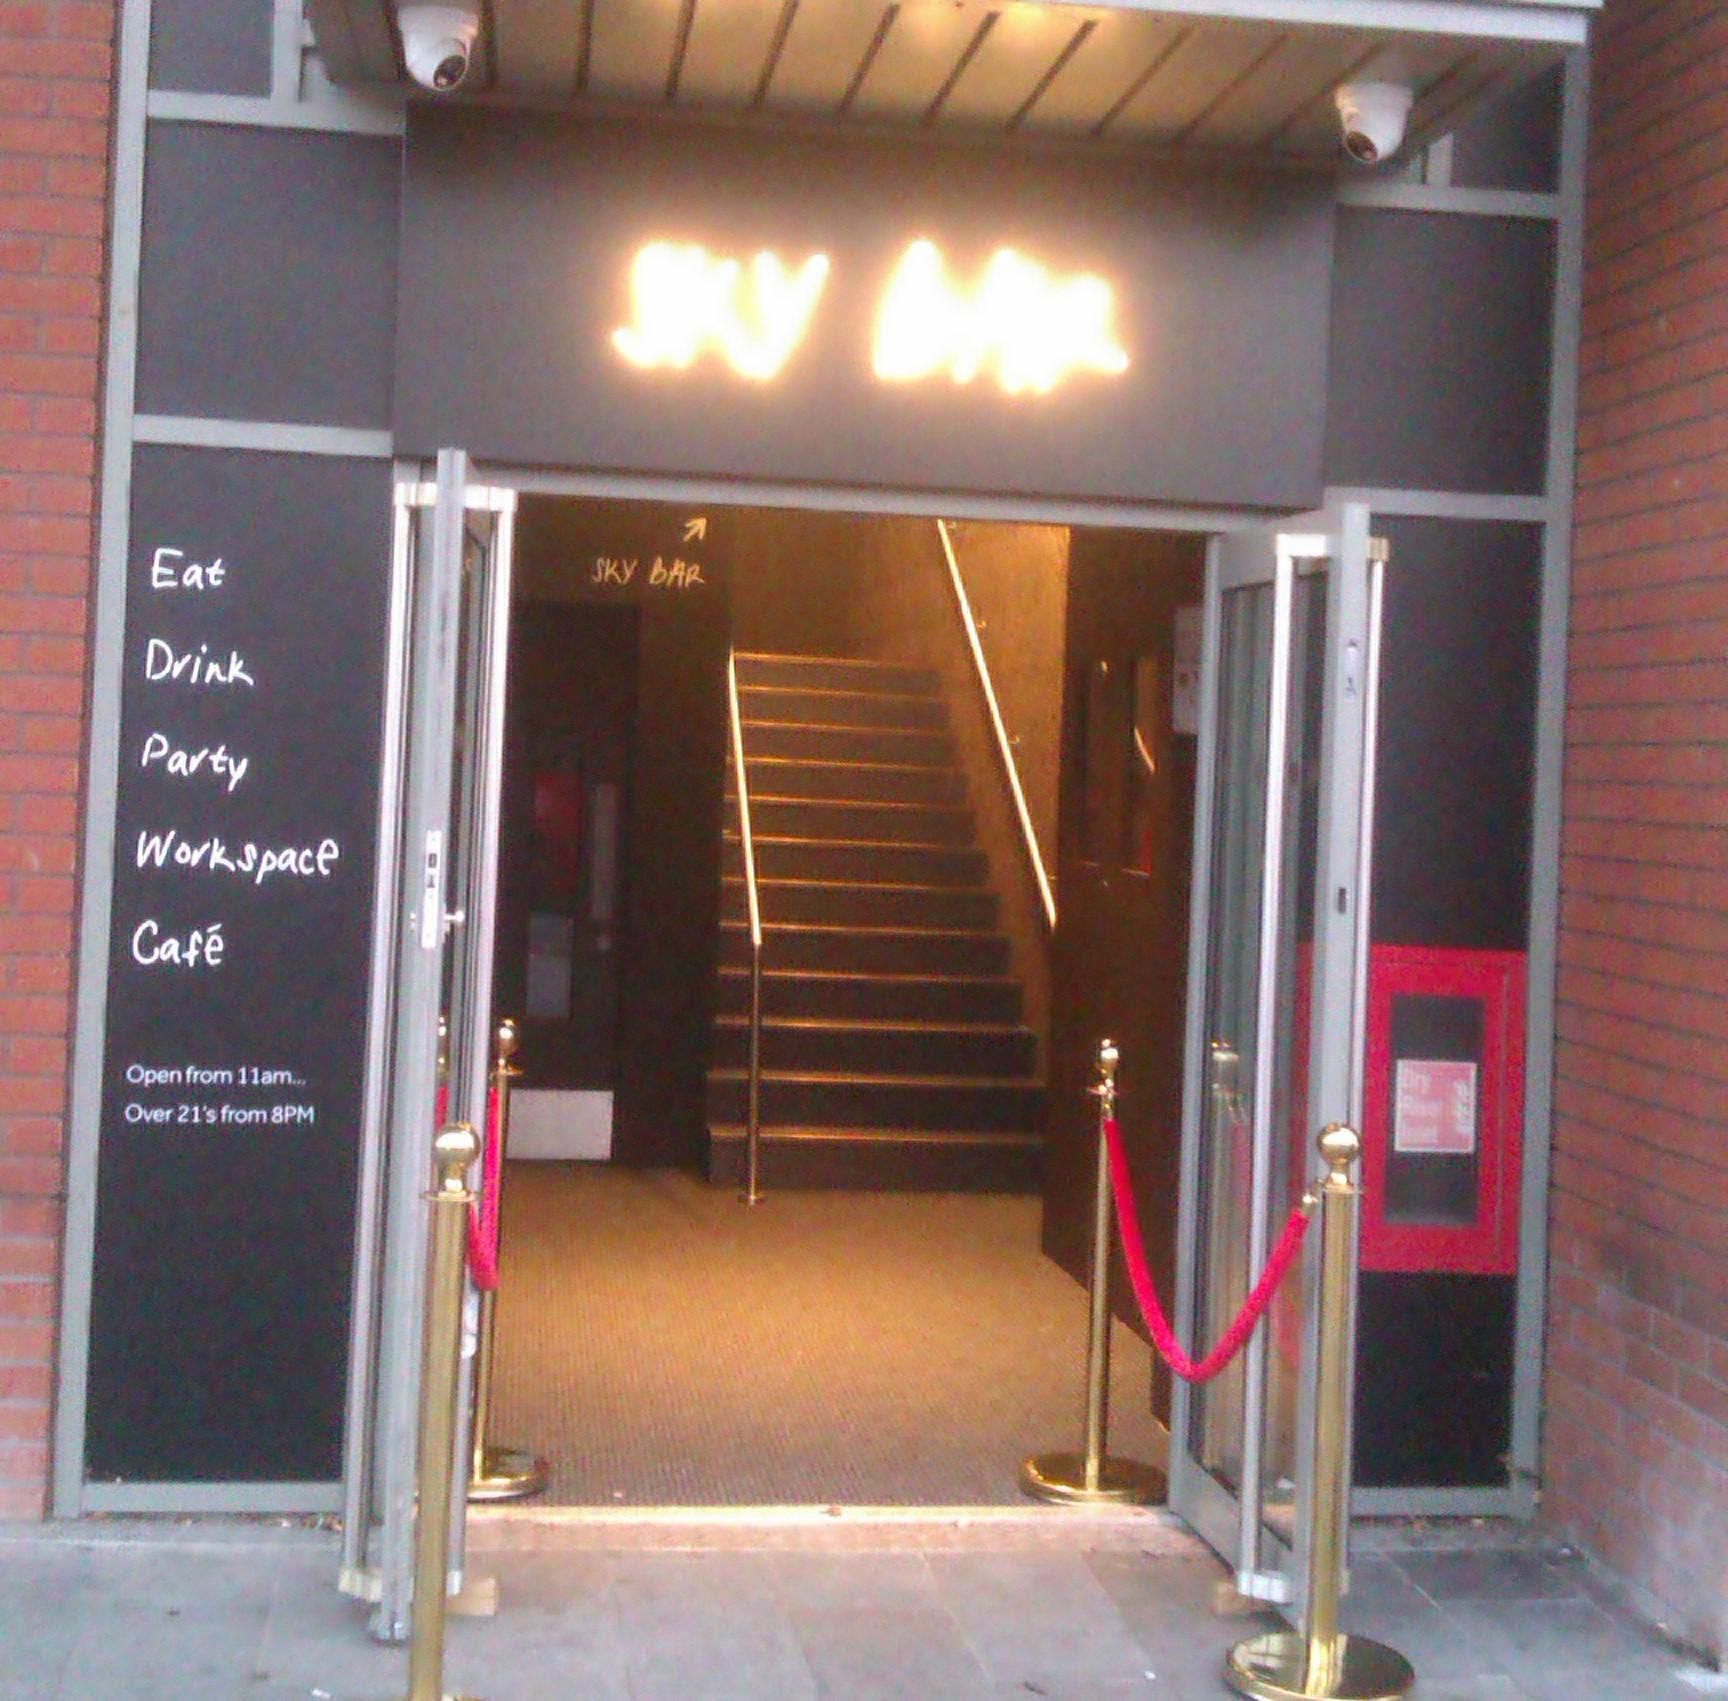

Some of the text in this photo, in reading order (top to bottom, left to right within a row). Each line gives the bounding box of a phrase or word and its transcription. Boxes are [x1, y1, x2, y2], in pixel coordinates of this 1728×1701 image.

[150, 547, 226, 591] Eat
[592, 554, 705, 589] SKY BAR
[145, 638, 255, 687] Drink
[141, 732, 249, 792] Party
[136, 829, 340, 885] Workspace
[132, 919, 225, 968] Café
[125, 1063, 182, 1088] Open
[185, 1065, 233, 1085] from
[124, 1103, 315, 1125] Over 21's from 8PM
